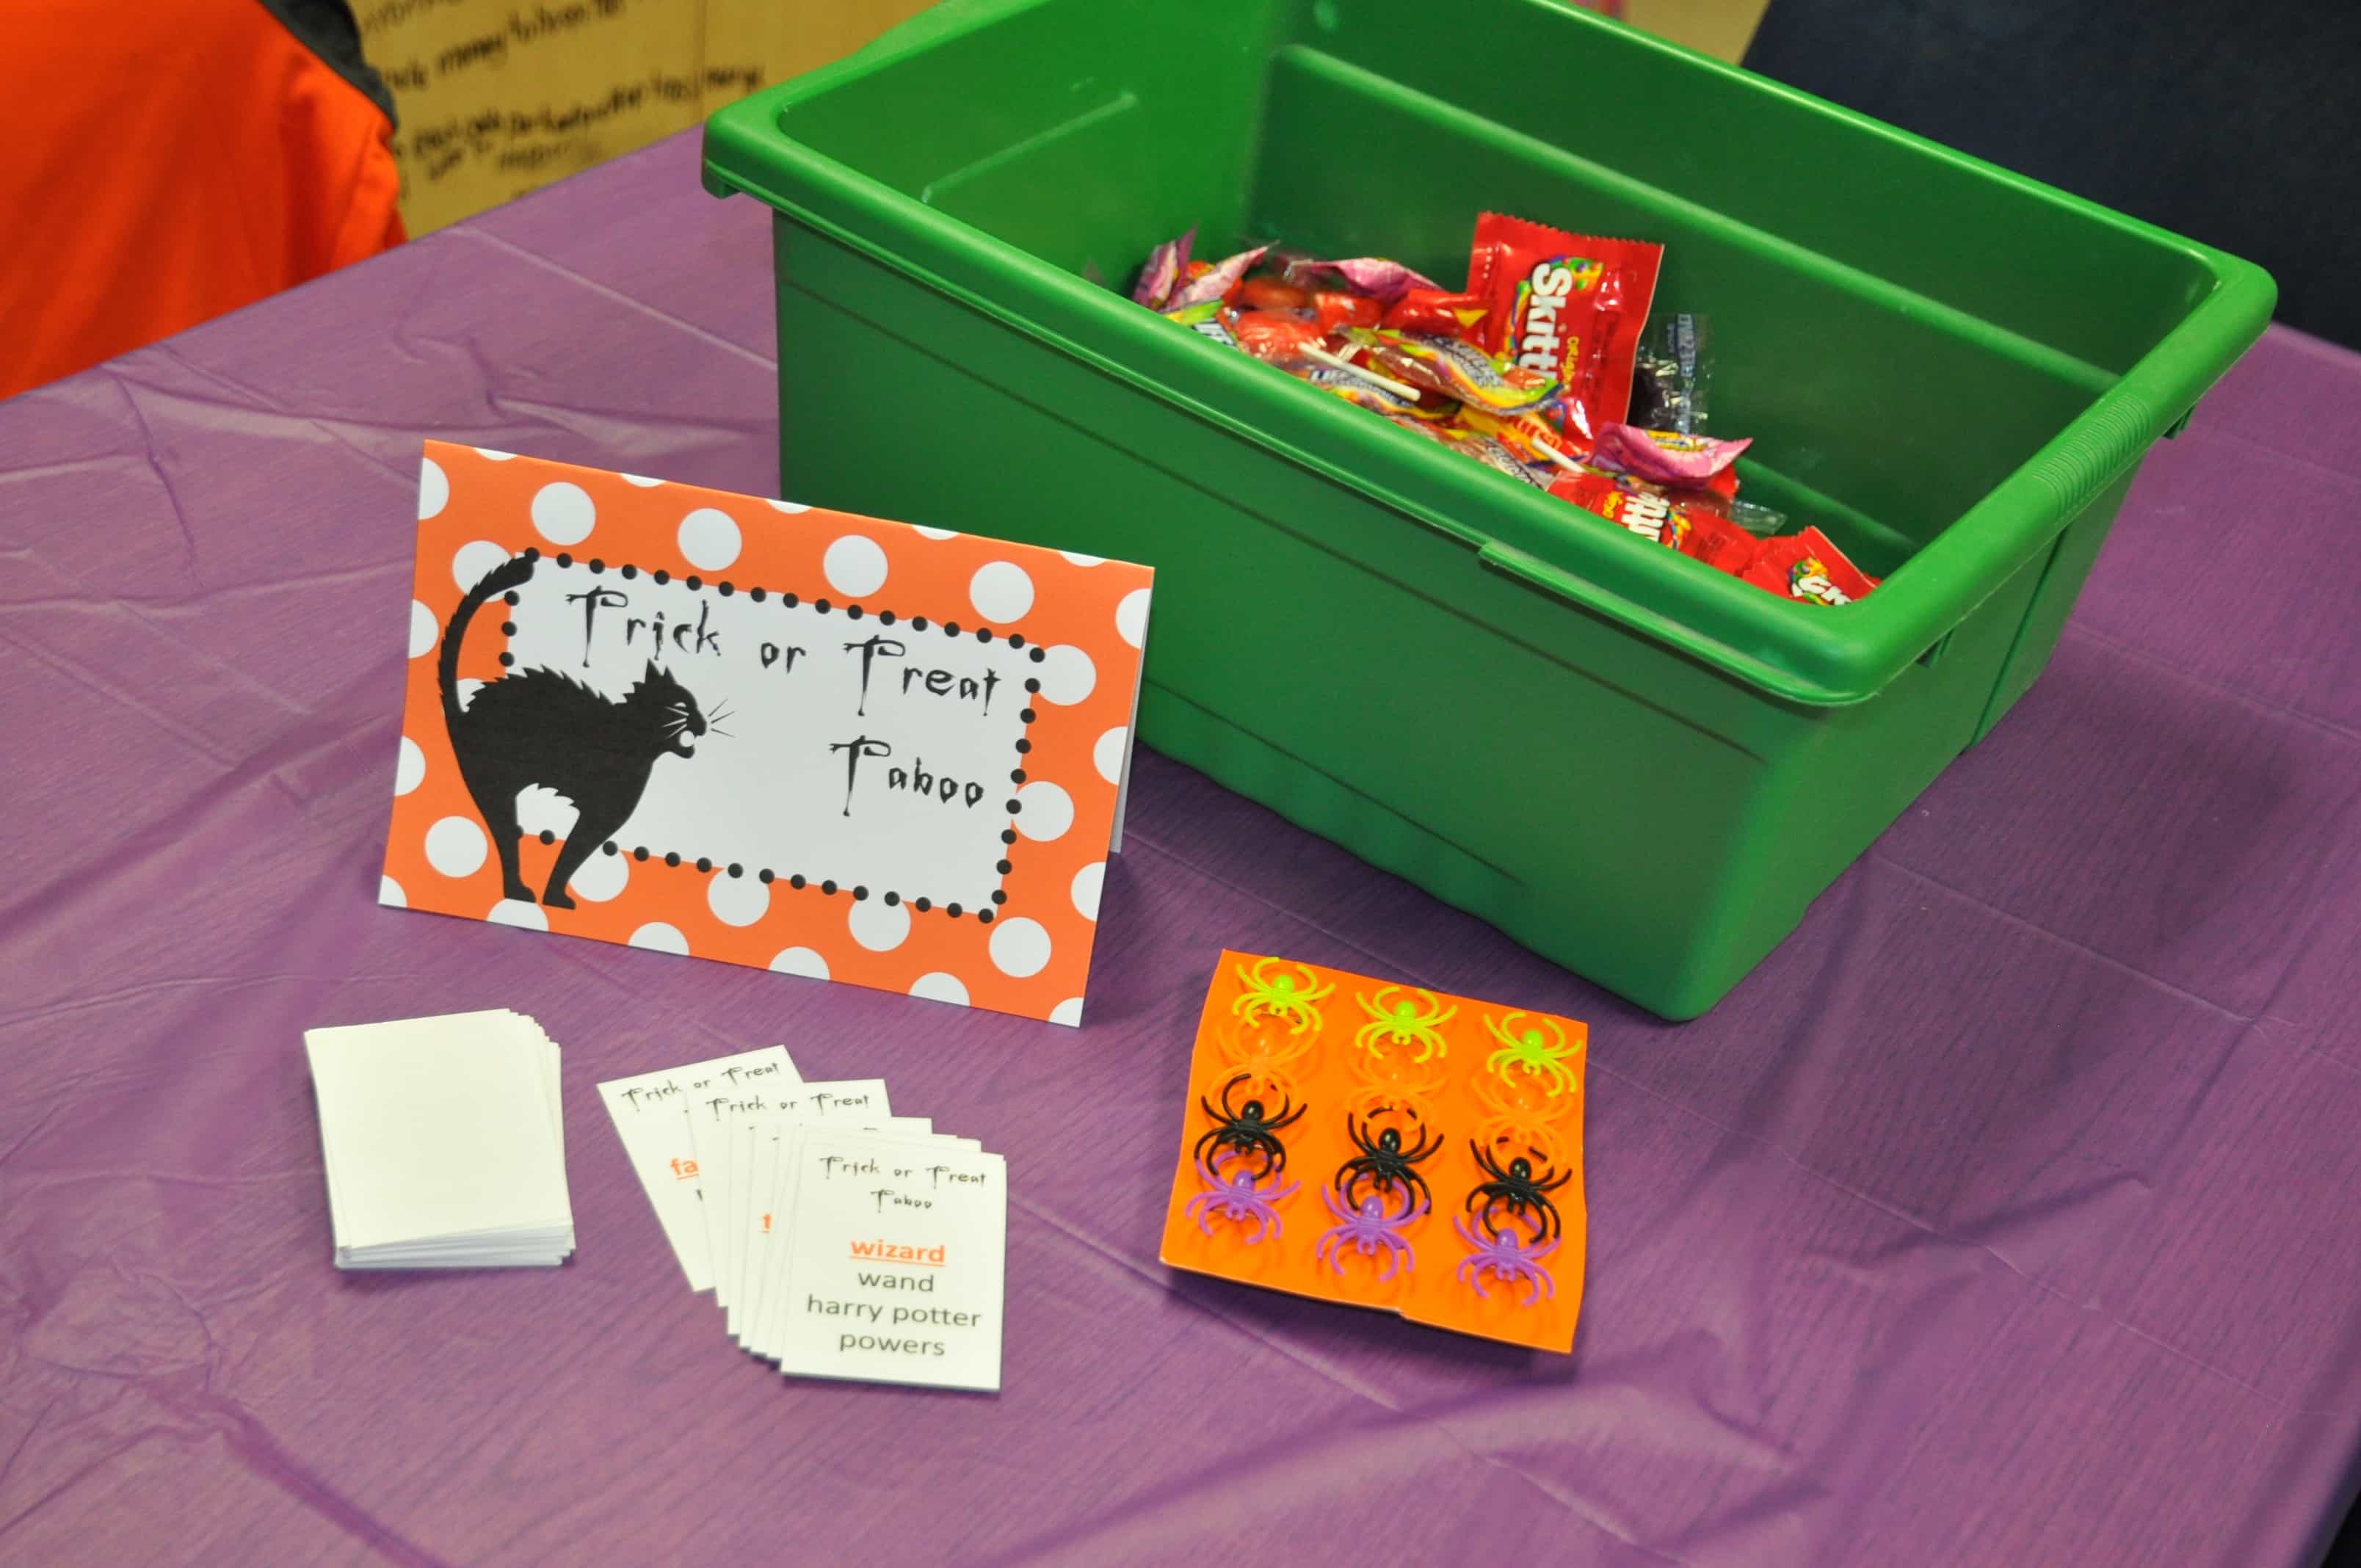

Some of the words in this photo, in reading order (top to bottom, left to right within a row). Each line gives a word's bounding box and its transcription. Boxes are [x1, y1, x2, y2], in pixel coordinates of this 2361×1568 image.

[1518, 262, 1573, 380] Skittl
[565, 585, 721, 668] Trick
[760, 641, 806, 675] or
[843, 634, 1001, 717] Treat
[828, 735, 984, 818] Taboo
[621, 1080, 682, 1112] Trick
[694, 1079, 711, 1089] or
[720, 1062, 780, 1086] Treat
[706, 1095, 766, 1122] Trick
[780, 1100, 798, 1111] or
[810, 1093, 869, 1116] Treat
[819, 1155, 881, 1180] Trick
[893, 1167, 913, 1178] or
[926, 1166, 987, 1189] Treat
[870, 1188, 933, 1213] Taboo
[849, 1239, 946, 1265] wizard
[857, 1271, 935, 1293] wand
[807, 1293, 883, 1324] harry
[893, 1305, 982, 1327] potter
[839, 1333, 946, 1357] powers
